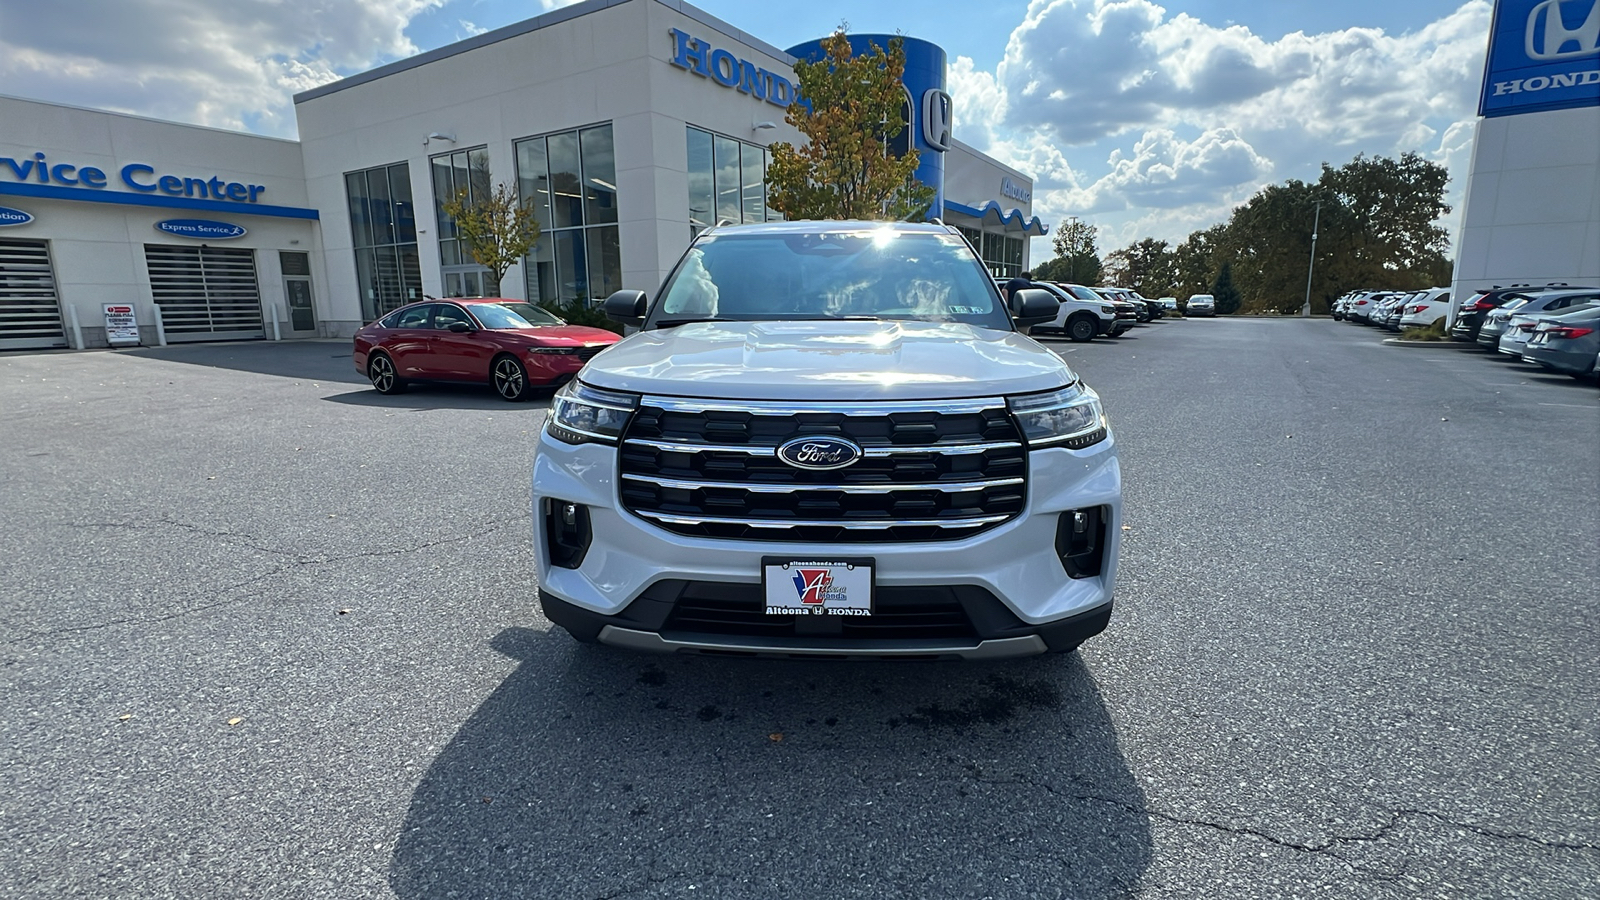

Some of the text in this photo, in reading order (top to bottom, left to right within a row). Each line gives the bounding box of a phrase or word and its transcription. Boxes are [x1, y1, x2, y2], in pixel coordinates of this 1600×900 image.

[121, 163, 265, 203] Center
[0, 212, 26, 220] tion
[161, 222, 230, 234] Express Service
[797, 443, 842, 462] Ford
[765, 606, 871, 616] Altoona HONDA
